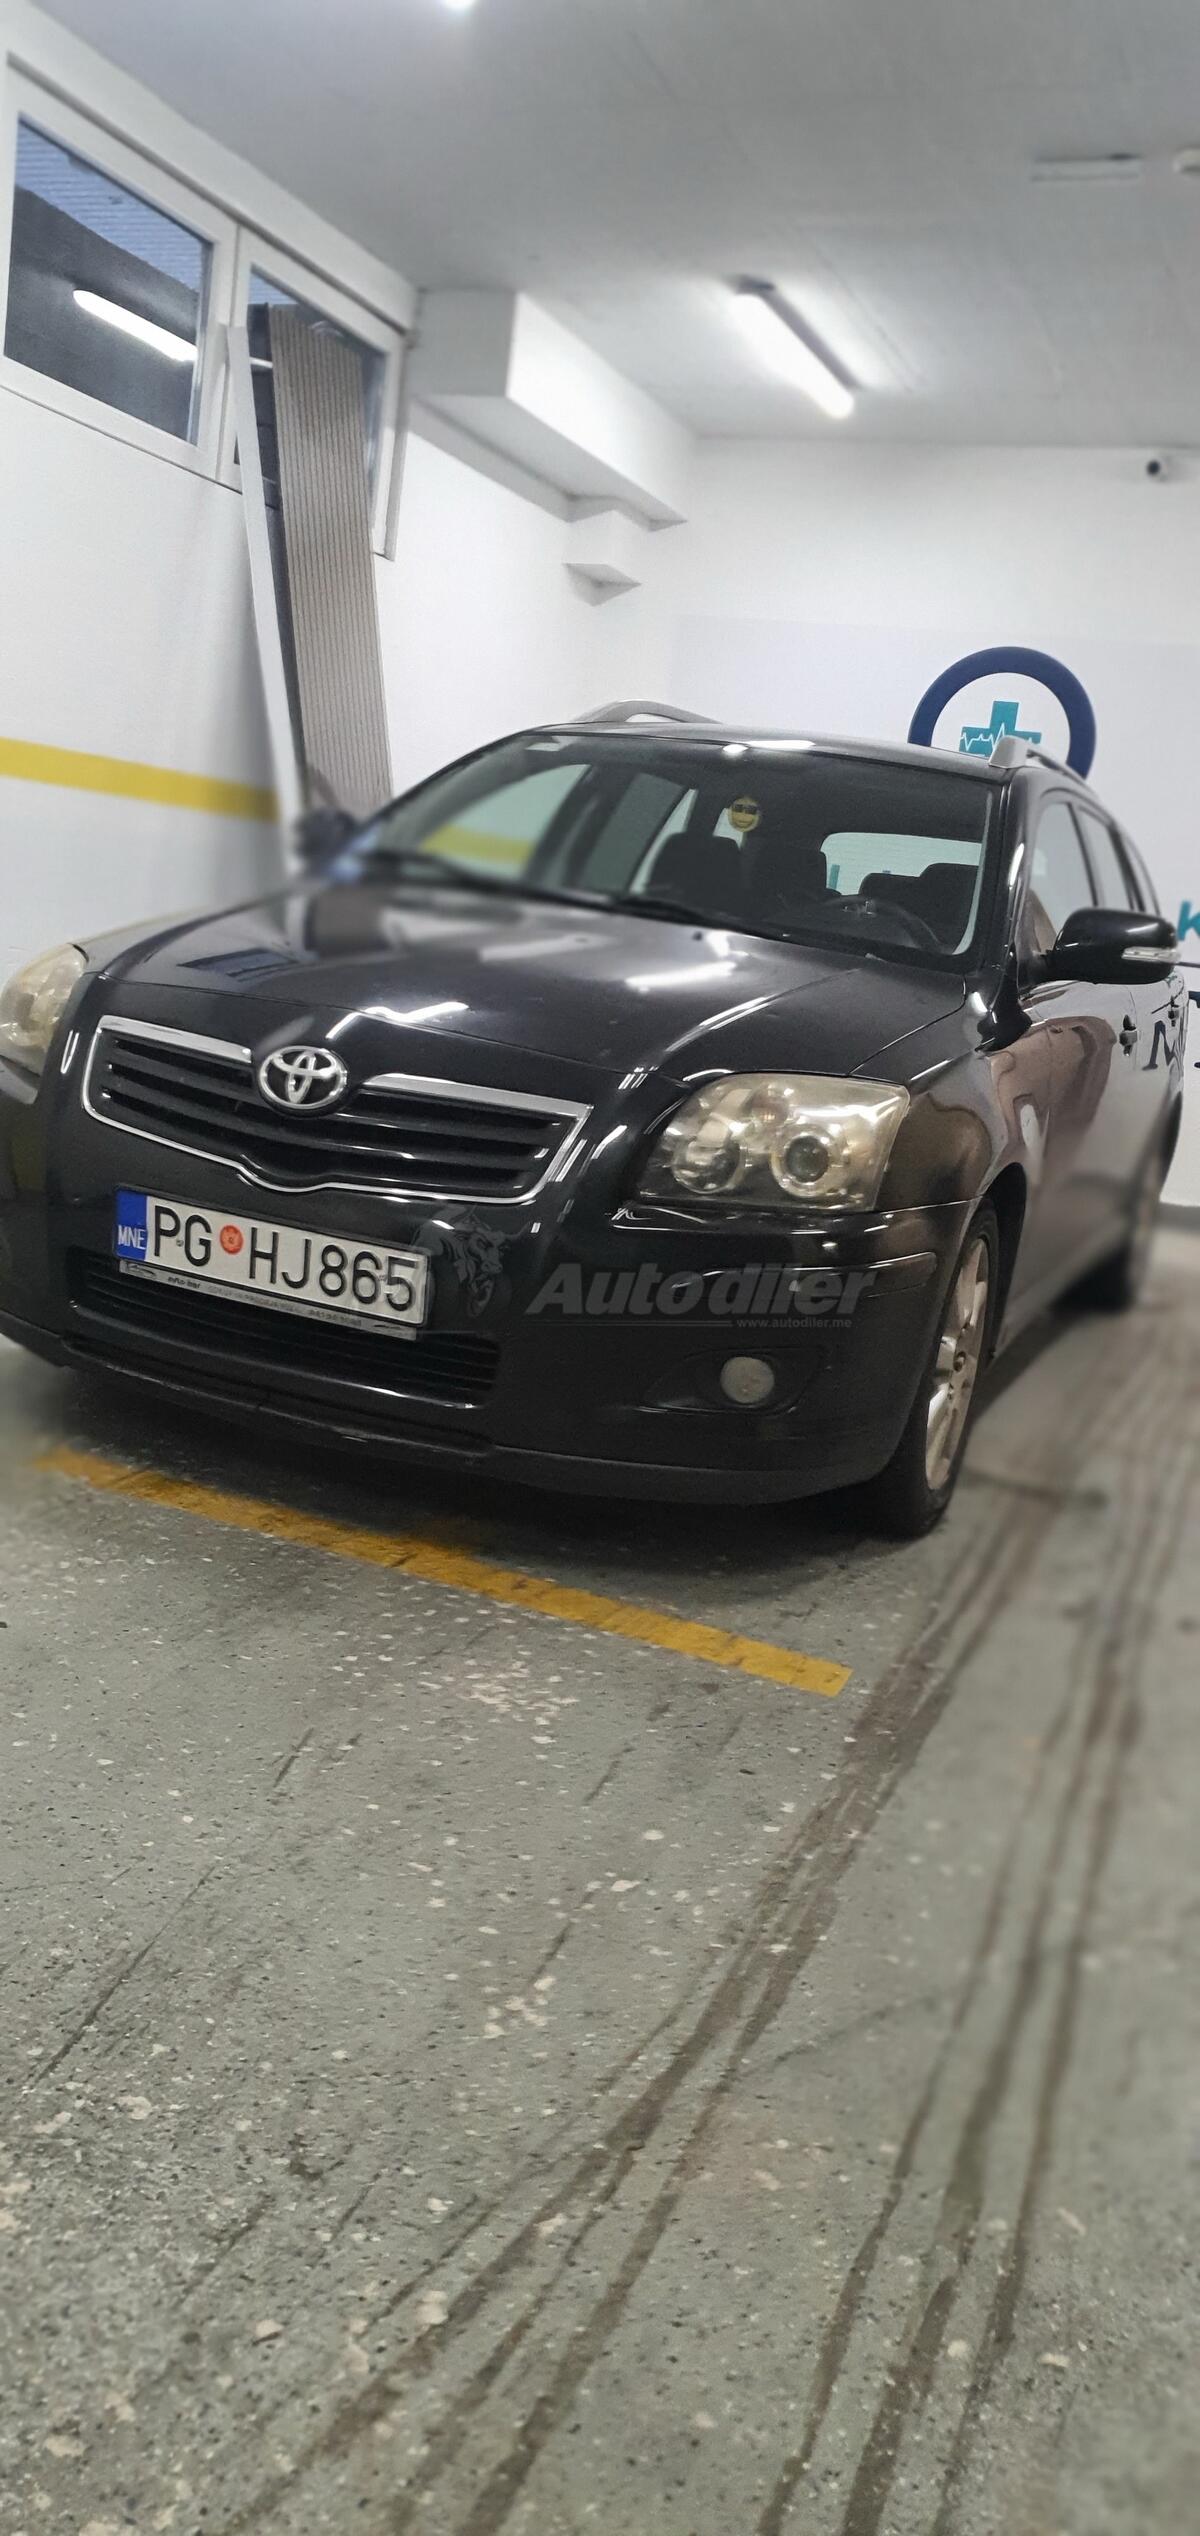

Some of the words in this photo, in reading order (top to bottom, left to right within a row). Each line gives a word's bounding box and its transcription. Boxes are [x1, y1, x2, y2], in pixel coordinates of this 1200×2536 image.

[118, 1223, 146, 1250] MNE
[154, 1205, 211, 1266] PG
[249, 1226, 417, 1311] HJ865
